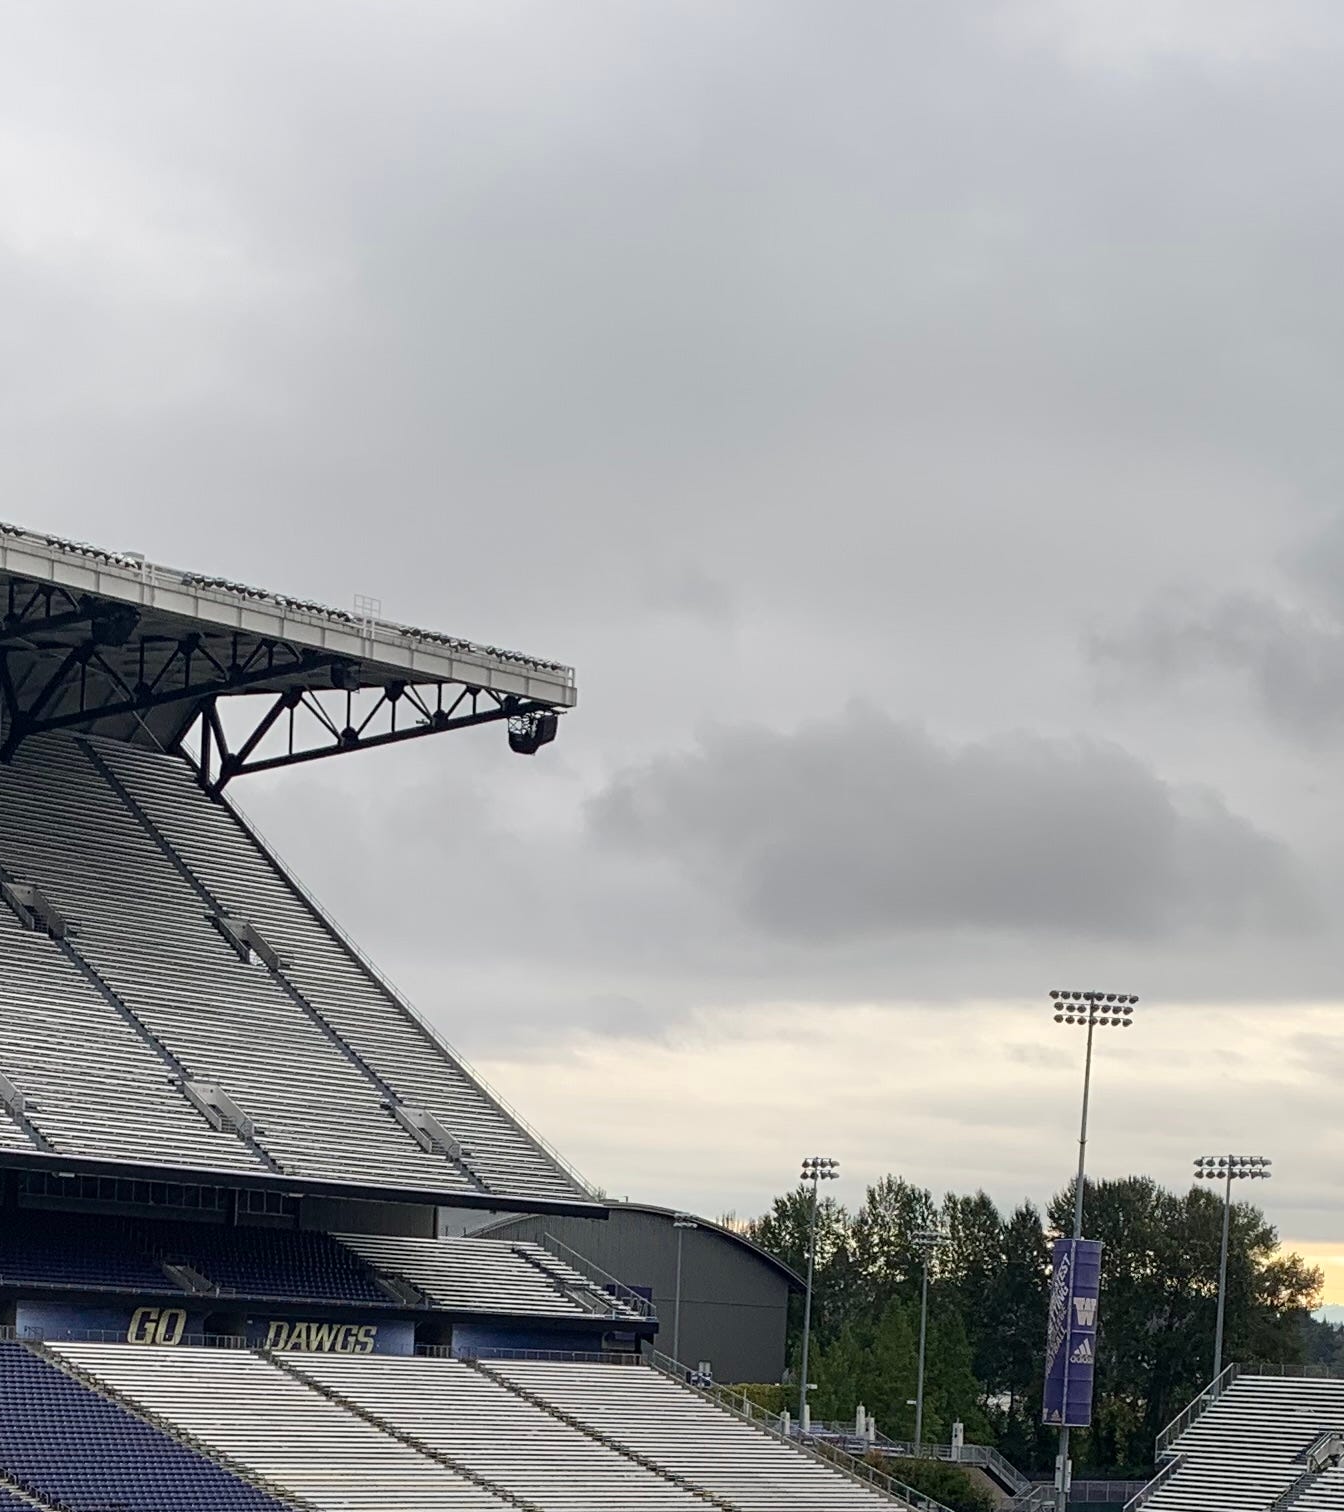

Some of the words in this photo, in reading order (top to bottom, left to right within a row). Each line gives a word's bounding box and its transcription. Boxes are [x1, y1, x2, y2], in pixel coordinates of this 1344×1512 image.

[127, 1306, 187, 1345] GO
[264, 1321, 378, 1354] DAWGS
[1073, 1297, 1097, 1326] W
